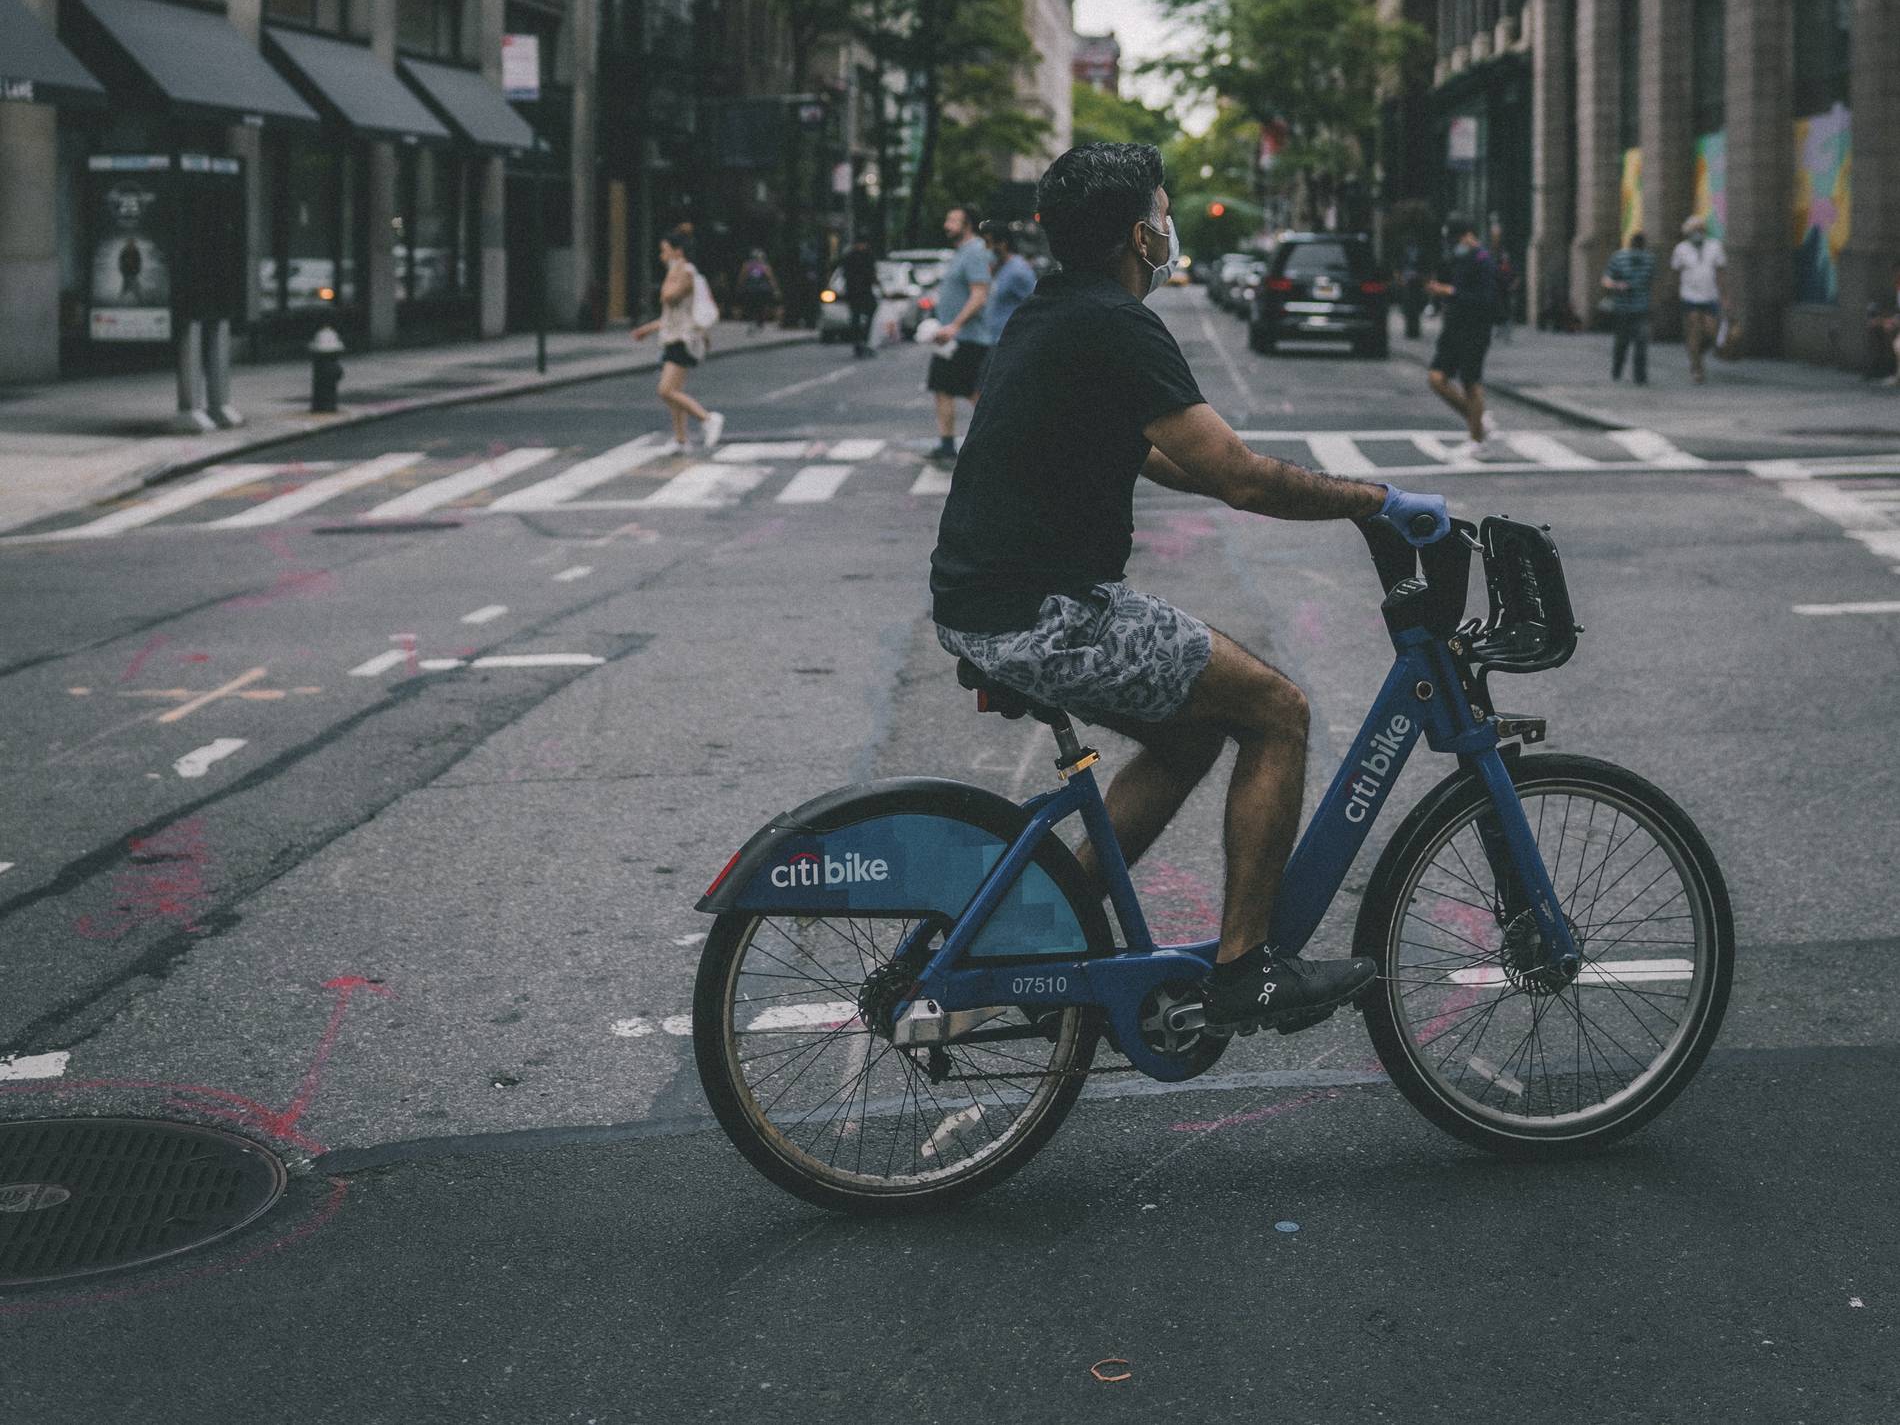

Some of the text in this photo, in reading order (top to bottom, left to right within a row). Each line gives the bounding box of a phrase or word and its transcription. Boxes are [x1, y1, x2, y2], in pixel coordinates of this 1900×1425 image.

[1345, 714, 1411, 823] citi bike
[770, 852, 889, 888] citi bike
[1012, 976, 1067, 994] 07510
